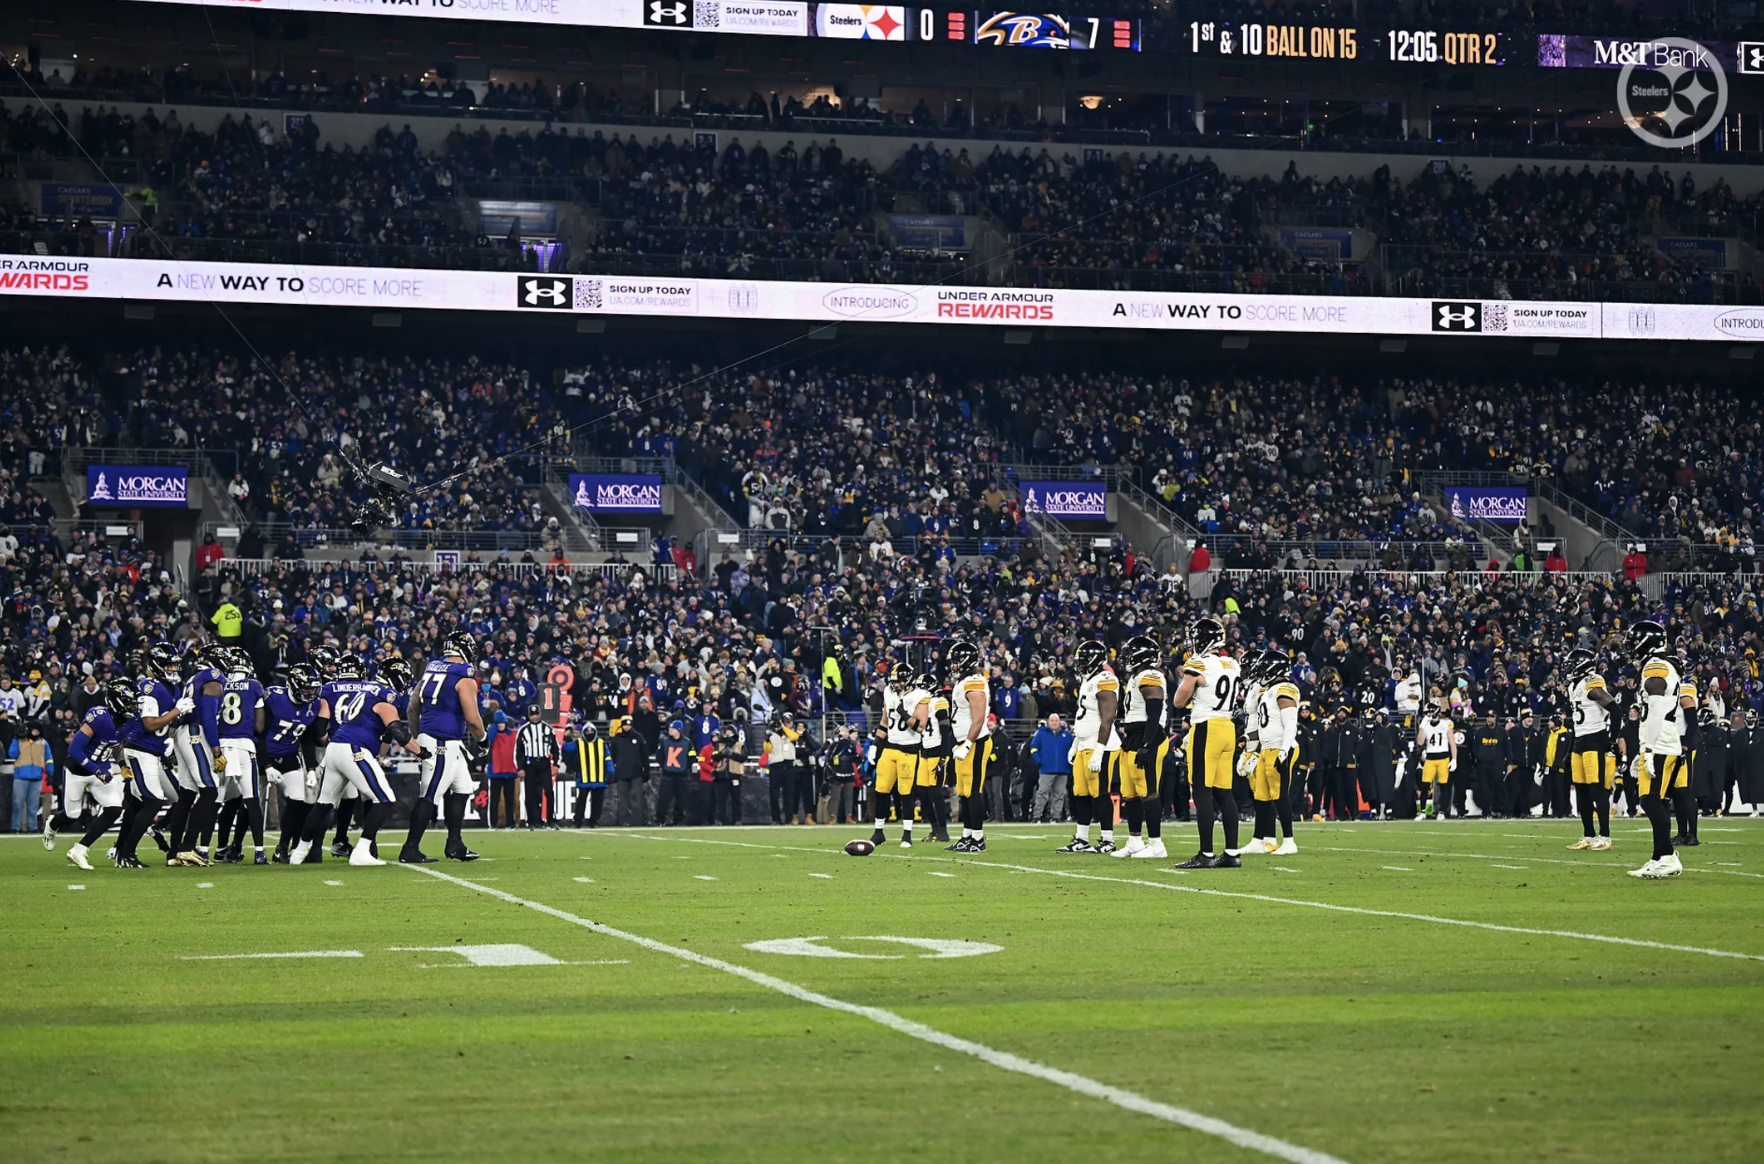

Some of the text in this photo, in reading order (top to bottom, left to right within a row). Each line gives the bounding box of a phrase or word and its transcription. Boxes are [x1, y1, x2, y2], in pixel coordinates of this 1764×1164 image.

[725, 7, 799, 17] SIGN UP TODAY
[725, 18, 799, 28] UA.COM/REWARDS
[830, 15, 862, 26] Steelers
[920, 9, 934, 41] 0
[1087, 18, 1099, 49] 7
[1191, 21, 1357, 59] 1st & 10 BALL ON 15
[1388, 30, 1497, 65] 12:05 QTR 2
[1594, 40, 1708, 68] M&T Bank
[16, 261, 89, 272] ARMOUR
[157, 273, 423, 297] A NEW WAY TO SCORE MORE
[609, 285, 691, 295] SIGN UP TODAY
[609, 297, 691, 307] UA.COM/REWARDS
[830, 296, 909, 309] INTRODUCING
[938, 291, 1053, 303] UNDER ARMOUR
[938, 303, 1053, 320] REWARDS
[1113, 303, 1347, 322] A NEW WAY TO SCORE MORE
[1514, 309, 1587, 319] SIGN UP TODAY
[1513, 319, 1587, 329] UA.COM/REWARDS
[118, 476, 186, 491] MORGAN
[118, 490, 186, 499] STATE UNIVERSITY
[597, 484, 661, 498] MORGAN
[619, 498, 661, 506] UNIVERSITY
[1045, 492, 1105, 505] MORGAN
[1470, 496, 1526, 510] MORGAN
[1045, 504, 1105, 512] STATE UNIVERSITY
[1489, 509, 1526, 517] UNIVERSITY
[933, 522, 940, 532] 9
[973, 520, 979, 530] 8
[1090, 552, 1096, 563] 8
[1291, 627, 1304, 641] 90
[419, 672, 448, 705] 77
[518, 686, 526, 697] 8
[656, 679, 668, 691] 89
[544, 688, 553, 710] 1
[1004, 696, 1012, 708] 9
[1361, 690, 1375, 704] 20
[222, 692, 242, 725] 8
[1077, 694, 1087, 721] 5
[1259, 701, 1270, 728] 0
[1571, 700, 1585, 725] 5
[272, 719, 307, 744] 79
[702, 720, 711, 735] 8
[738, 729, 746, 743] 8
[1429, 733, 1443, 746] 41
[666, 747, 683, 769] K
